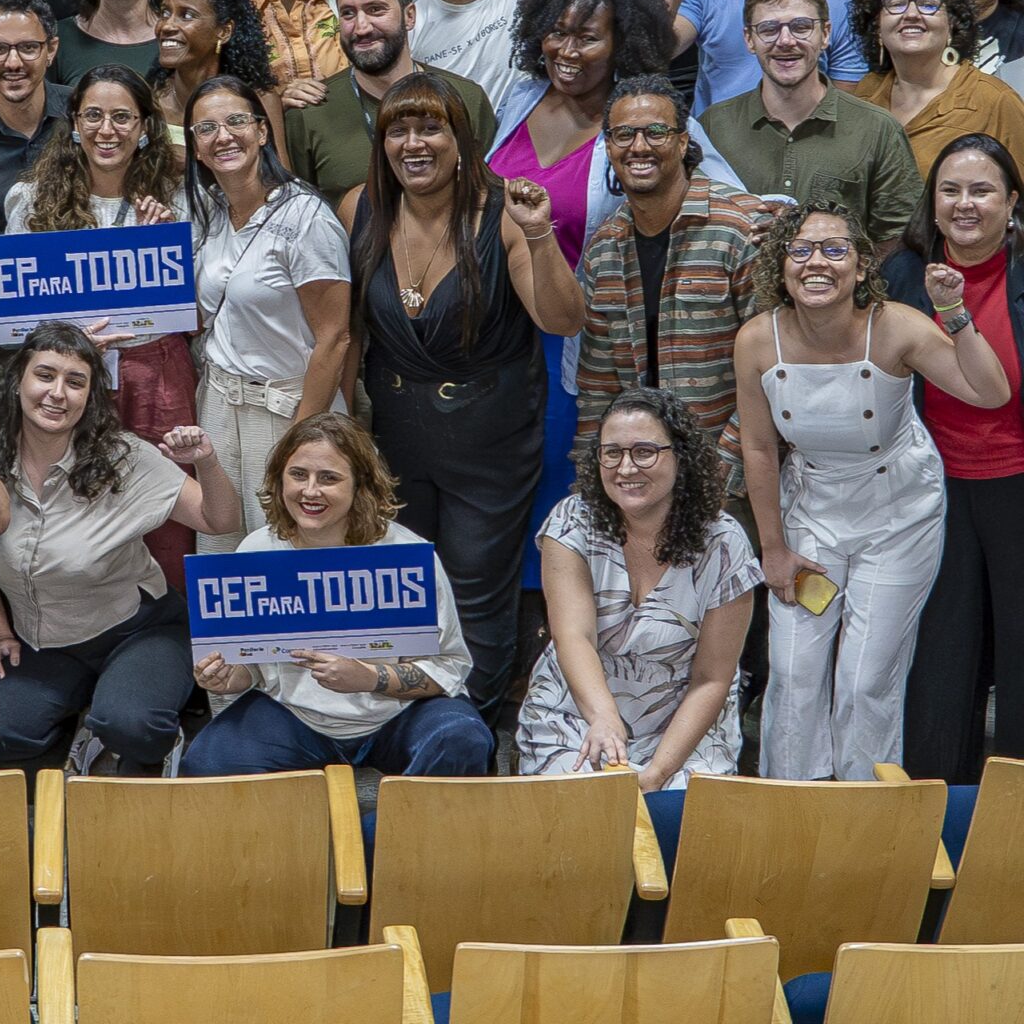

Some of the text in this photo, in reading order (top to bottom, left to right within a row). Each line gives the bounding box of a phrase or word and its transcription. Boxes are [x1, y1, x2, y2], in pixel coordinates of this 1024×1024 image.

[28, 276, 73, 296] PARA
[65, 245, 185, 294] TODOS
[197, 566, 426, 620] CEP PARA TODOS
